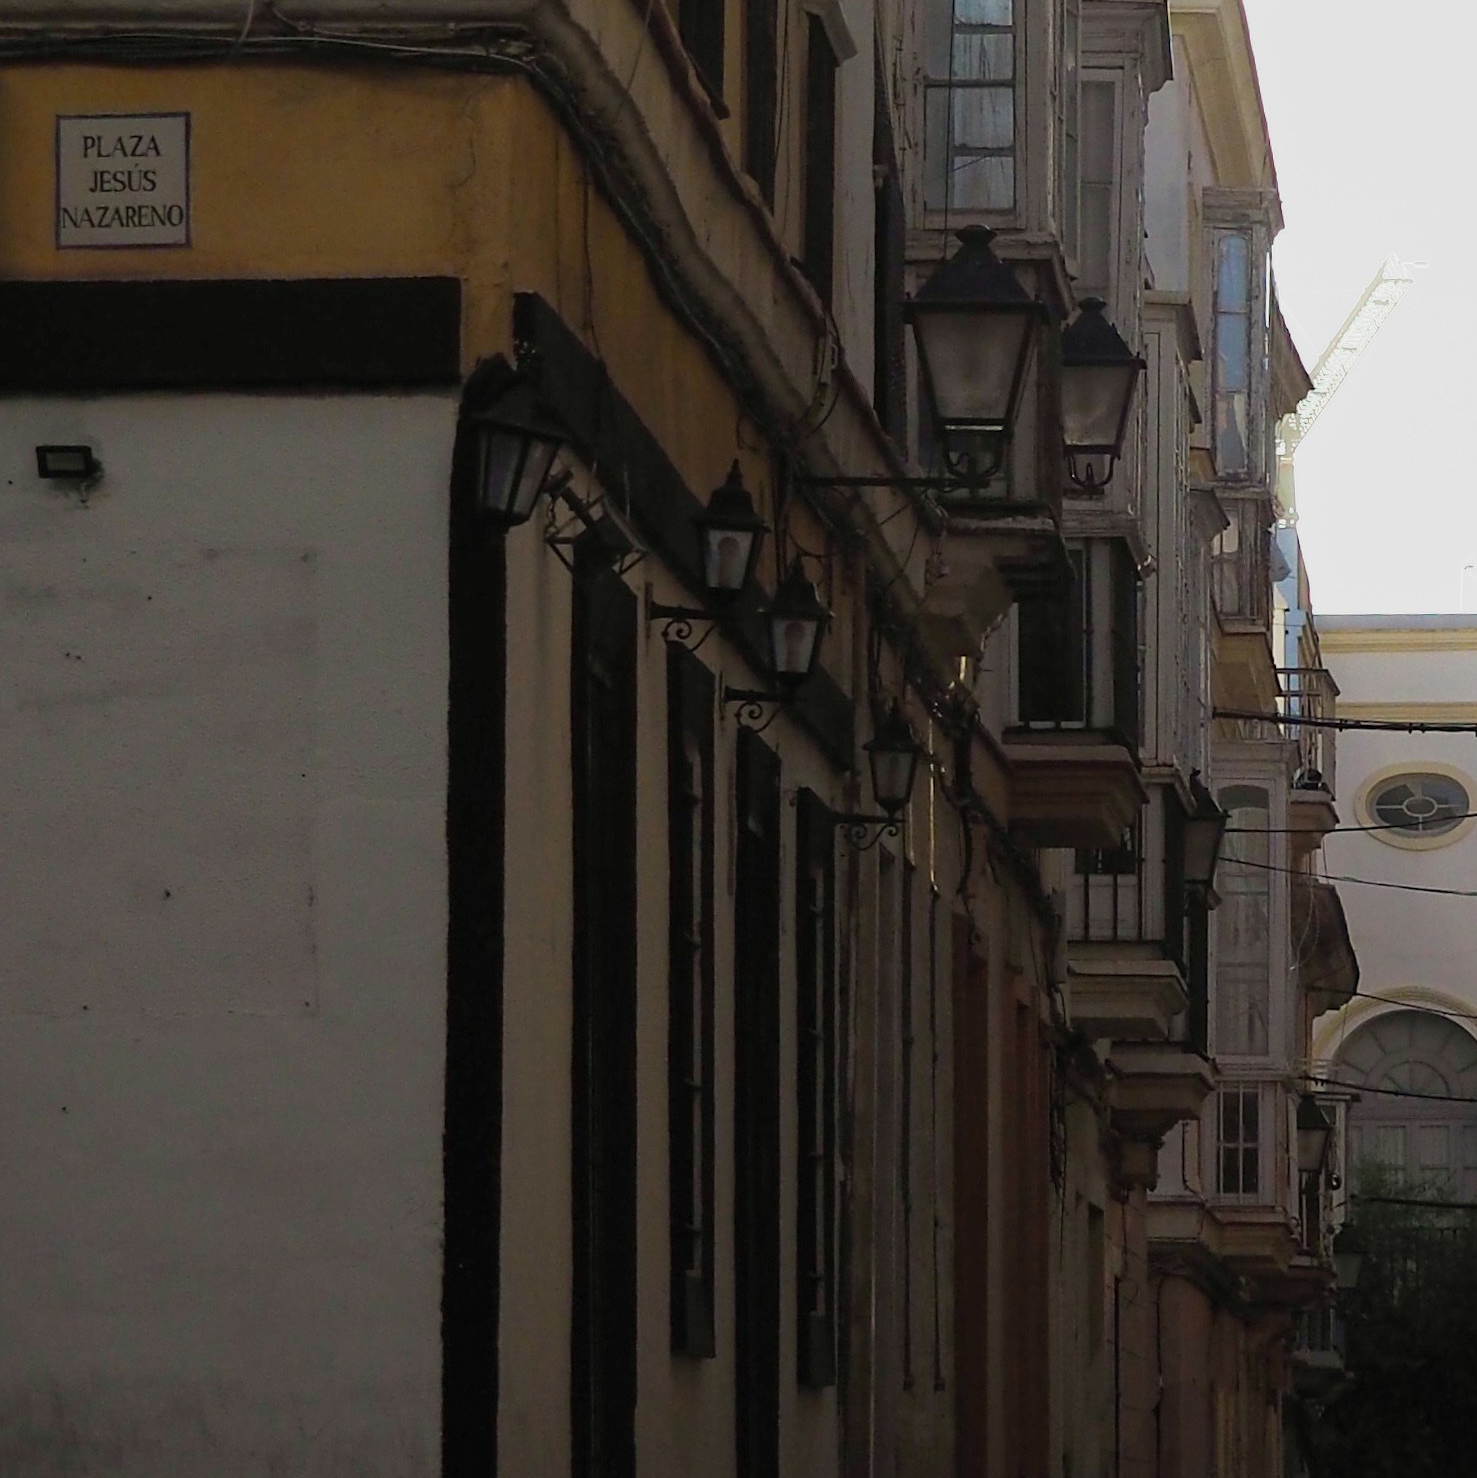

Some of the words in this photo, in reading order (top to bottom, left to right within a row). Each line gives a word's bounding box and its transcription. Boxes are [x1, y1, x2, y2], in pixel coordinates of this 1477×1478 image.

[82, 135, 161, 158] PLAZA
[89, 163, 157, 193] JESÚS
[61, 204, 184, 229] NAZARENO
